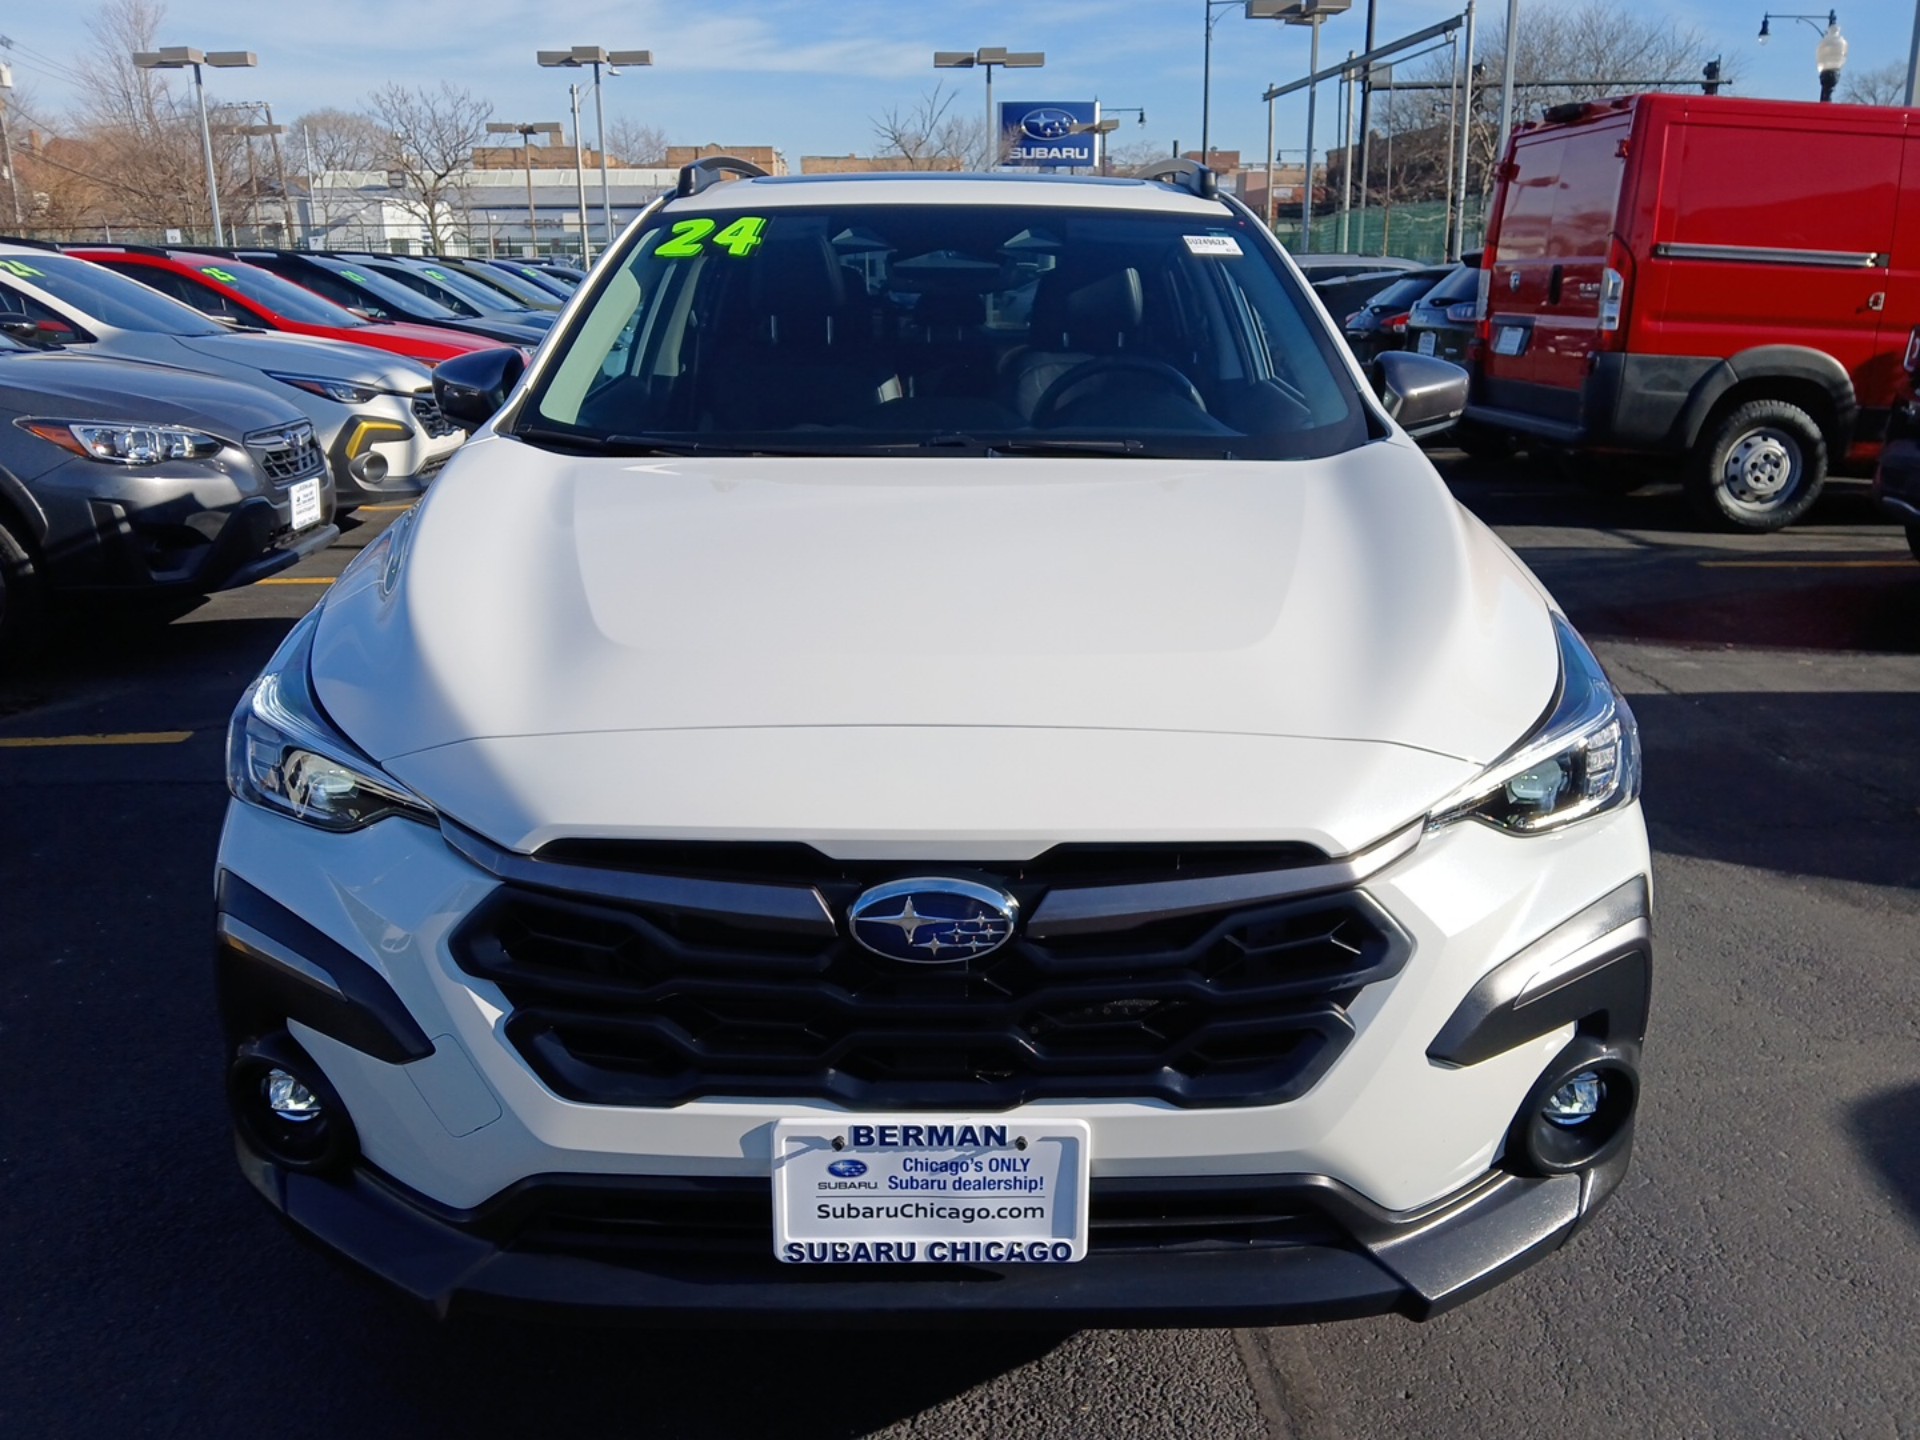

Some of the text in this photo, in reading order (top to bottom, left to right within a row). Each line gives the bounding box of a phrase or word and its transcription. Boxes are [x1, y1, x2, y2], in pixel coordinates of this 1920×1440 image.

[1010, 147, 1089, 159] SUBARU
[654, 216, 766, 257] 24
[852, 1125, 1008, 1148] BERMAN
[902, 1157, 1031, 1175] Chicago's ONLY
[817, 1181, 878, 1190] SUBARU
[888, 1176, 1044, 1193] Subaru dealership!
[816, 1203, 1045, 1223] SubaruChicago.com
[786, 1242, 1073, 1262] SUBARU CHICAGO
